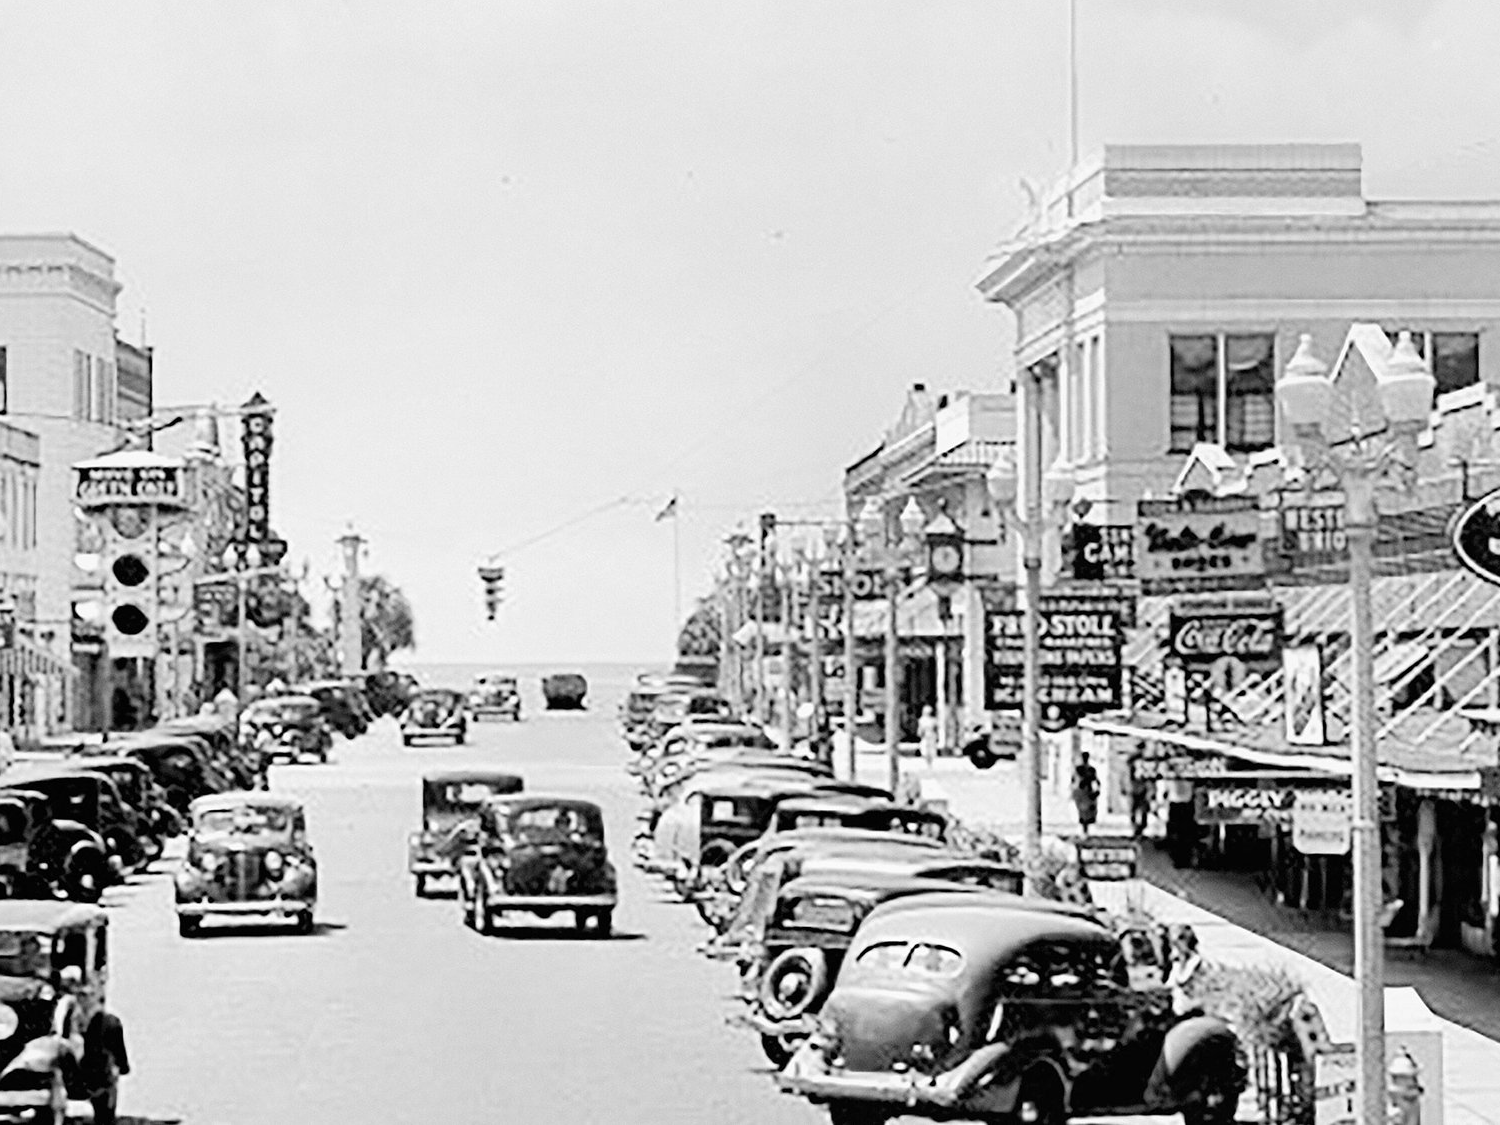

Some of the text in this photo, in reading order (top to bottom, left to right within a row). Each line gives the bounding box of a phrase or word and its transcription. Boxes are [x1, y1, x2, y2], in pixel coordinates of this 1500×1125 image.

[248, 416, 265, 539] CAPITOL
[1282, 507, 1346, 530] WESTE
[989, 614, 1116, 636] FRD STOLL
[1174, 618, 1275, 655] Coca-Cola
